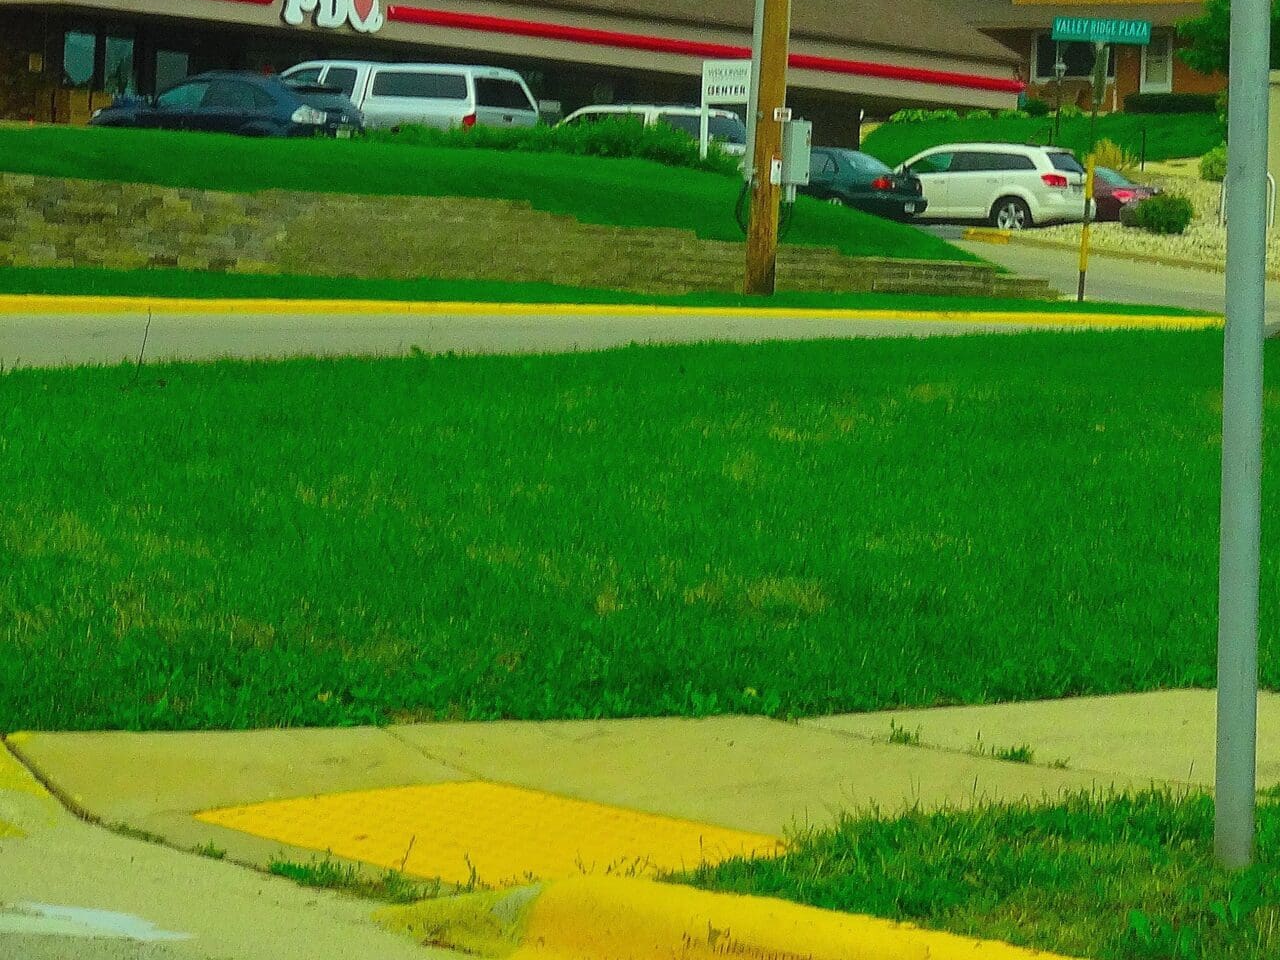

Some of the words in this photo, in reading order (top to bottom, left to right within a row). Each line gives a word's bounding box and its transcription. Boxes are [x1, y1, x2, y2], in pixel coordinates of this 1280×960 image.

[1055, 18, 1089, 34] VALLEY
[1090, 19, 1117, 35] RIDGE
[1118, 20, 1148, 37] PLAZA
